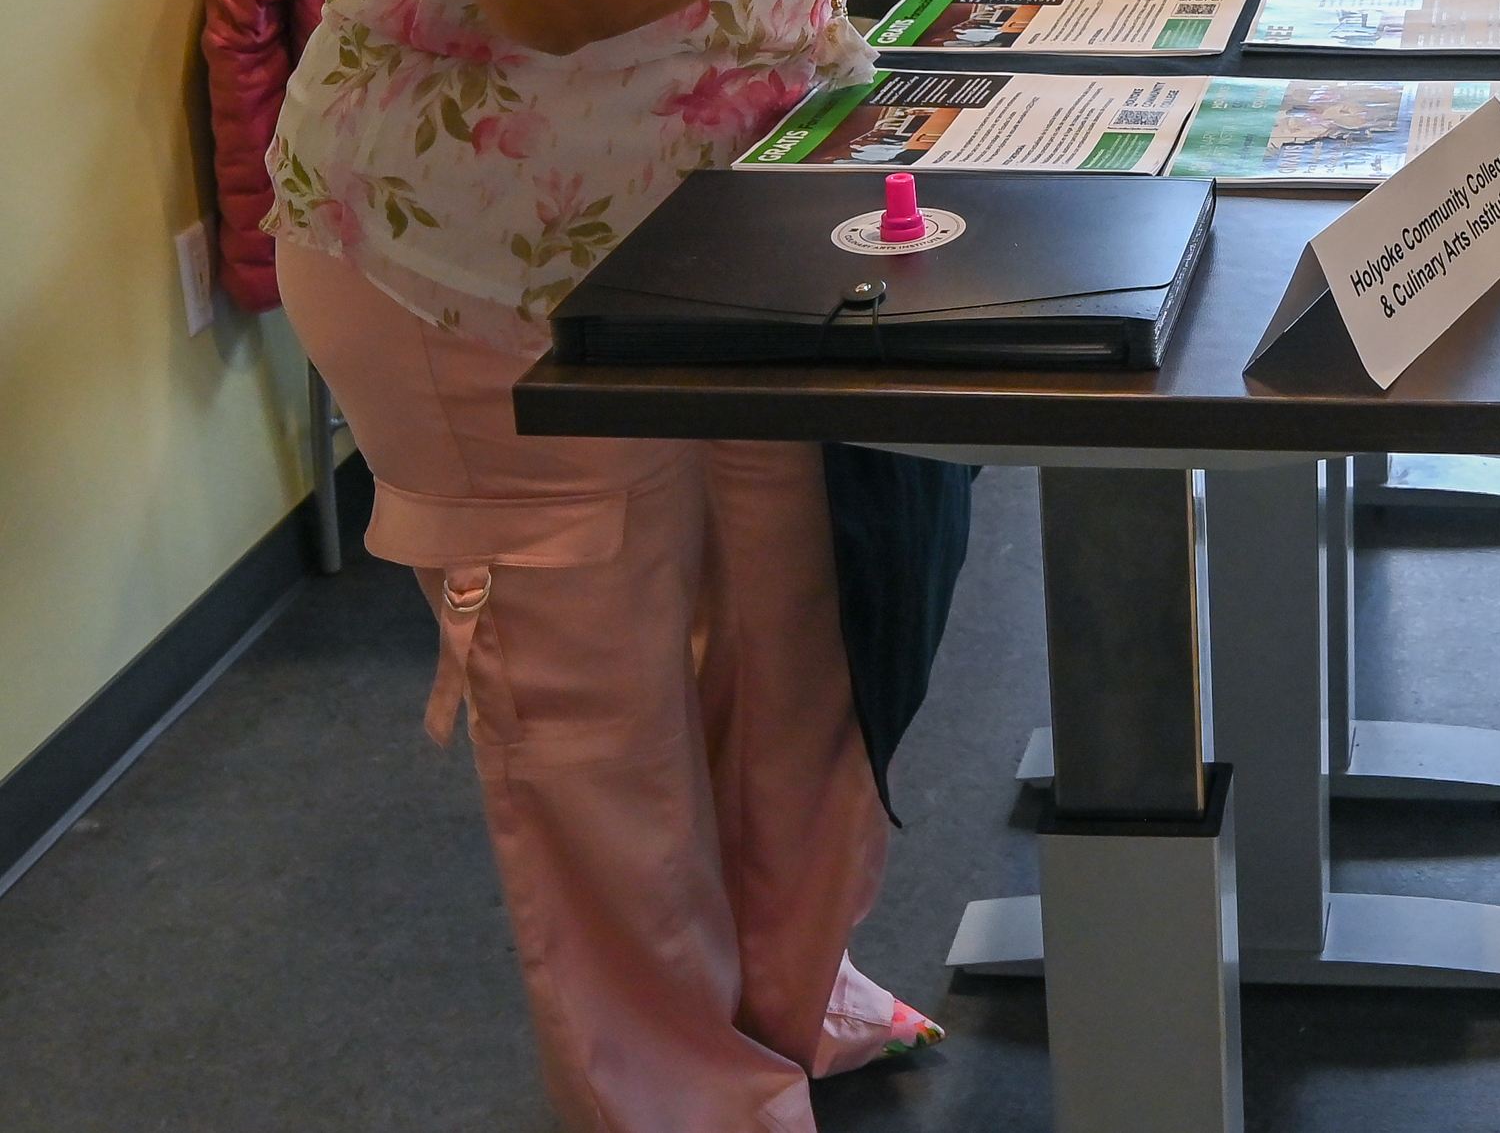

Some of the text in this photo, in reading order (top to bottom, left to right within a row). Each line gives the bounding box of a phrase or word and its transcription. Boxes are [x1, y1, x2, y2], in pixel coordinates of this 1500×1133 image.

[877, 19, 914, 44] GRATIS
[758, 130, 809, 162] GRATIS
[1349, 241, 1405, 298] Holyoke
[1401, 185, 1471, 252] Community
[1380, 295, 1396, 319] &
[1392, 248, 1446, 307] Culinary
[1442, 231, 1472, 264] Arts
